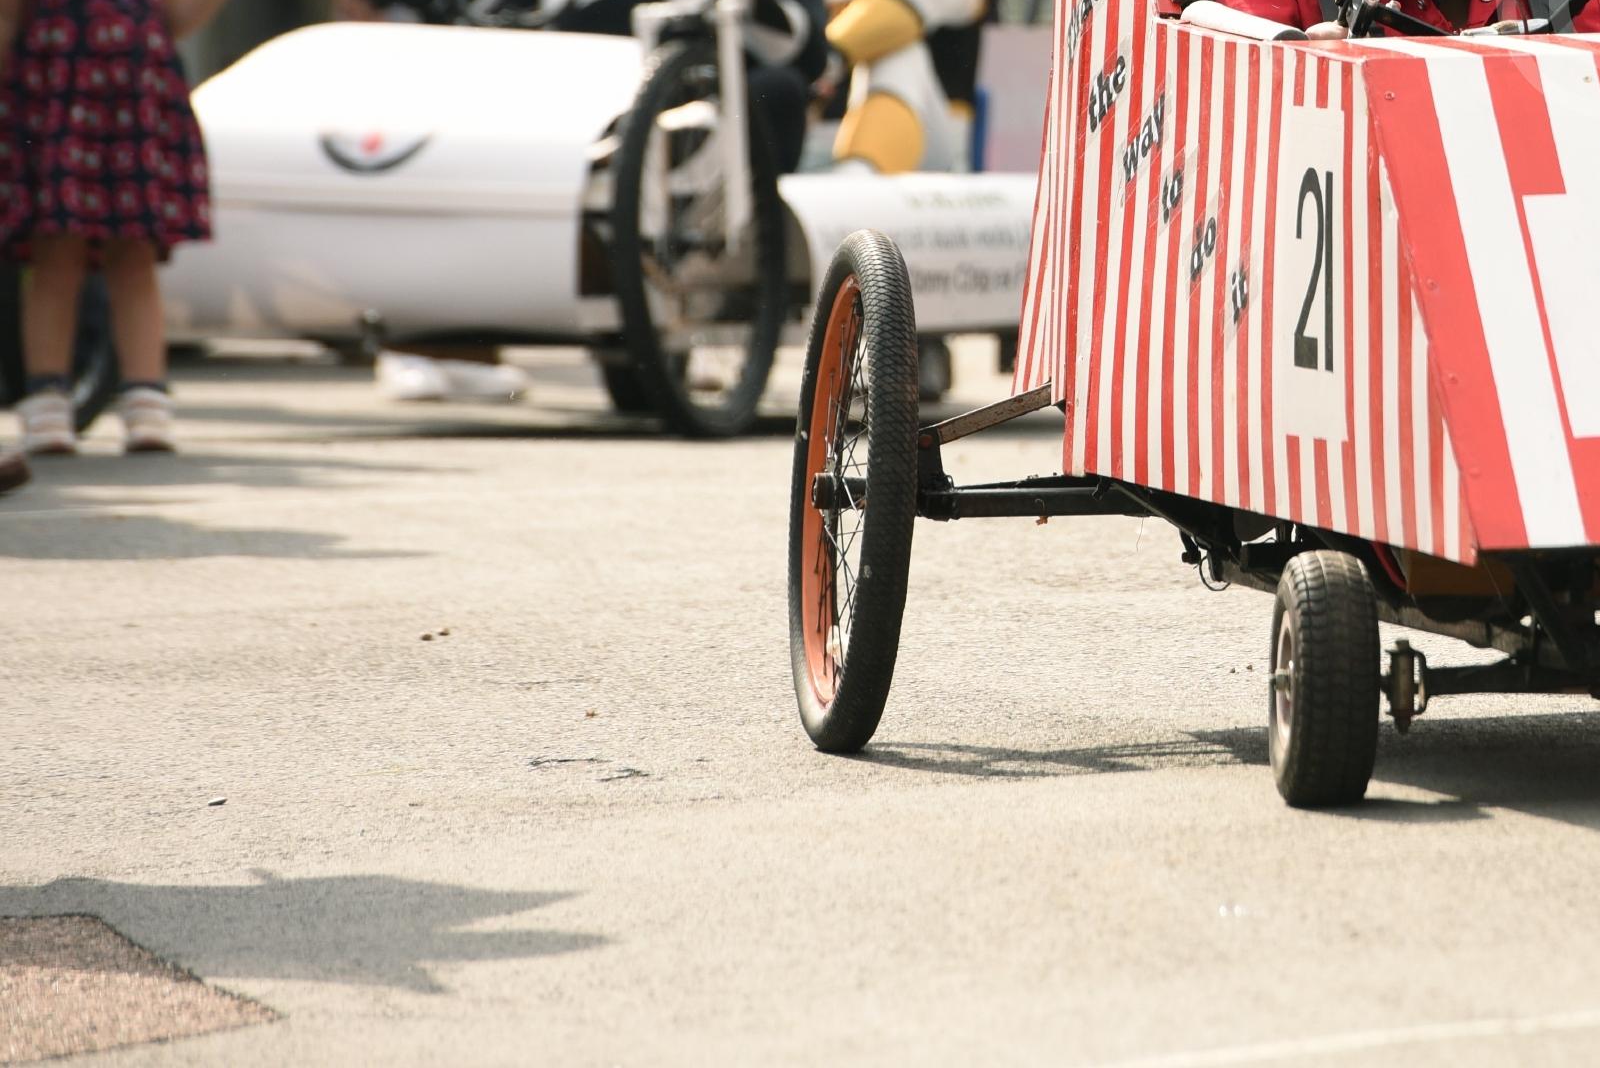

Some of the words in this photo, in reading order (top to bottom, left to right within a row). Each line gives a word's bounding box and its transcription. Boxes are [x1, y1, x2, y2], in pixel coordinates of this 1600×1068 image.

[1088, 55, 1126, 133] the
[1123, 92, 1166, 183] way
[1162, 169, 1184, 224] to
[1190, 216, 1217, 282] do
[1231, 262, 1248, 324] it
[1293, 167, 1334, 373] 21
